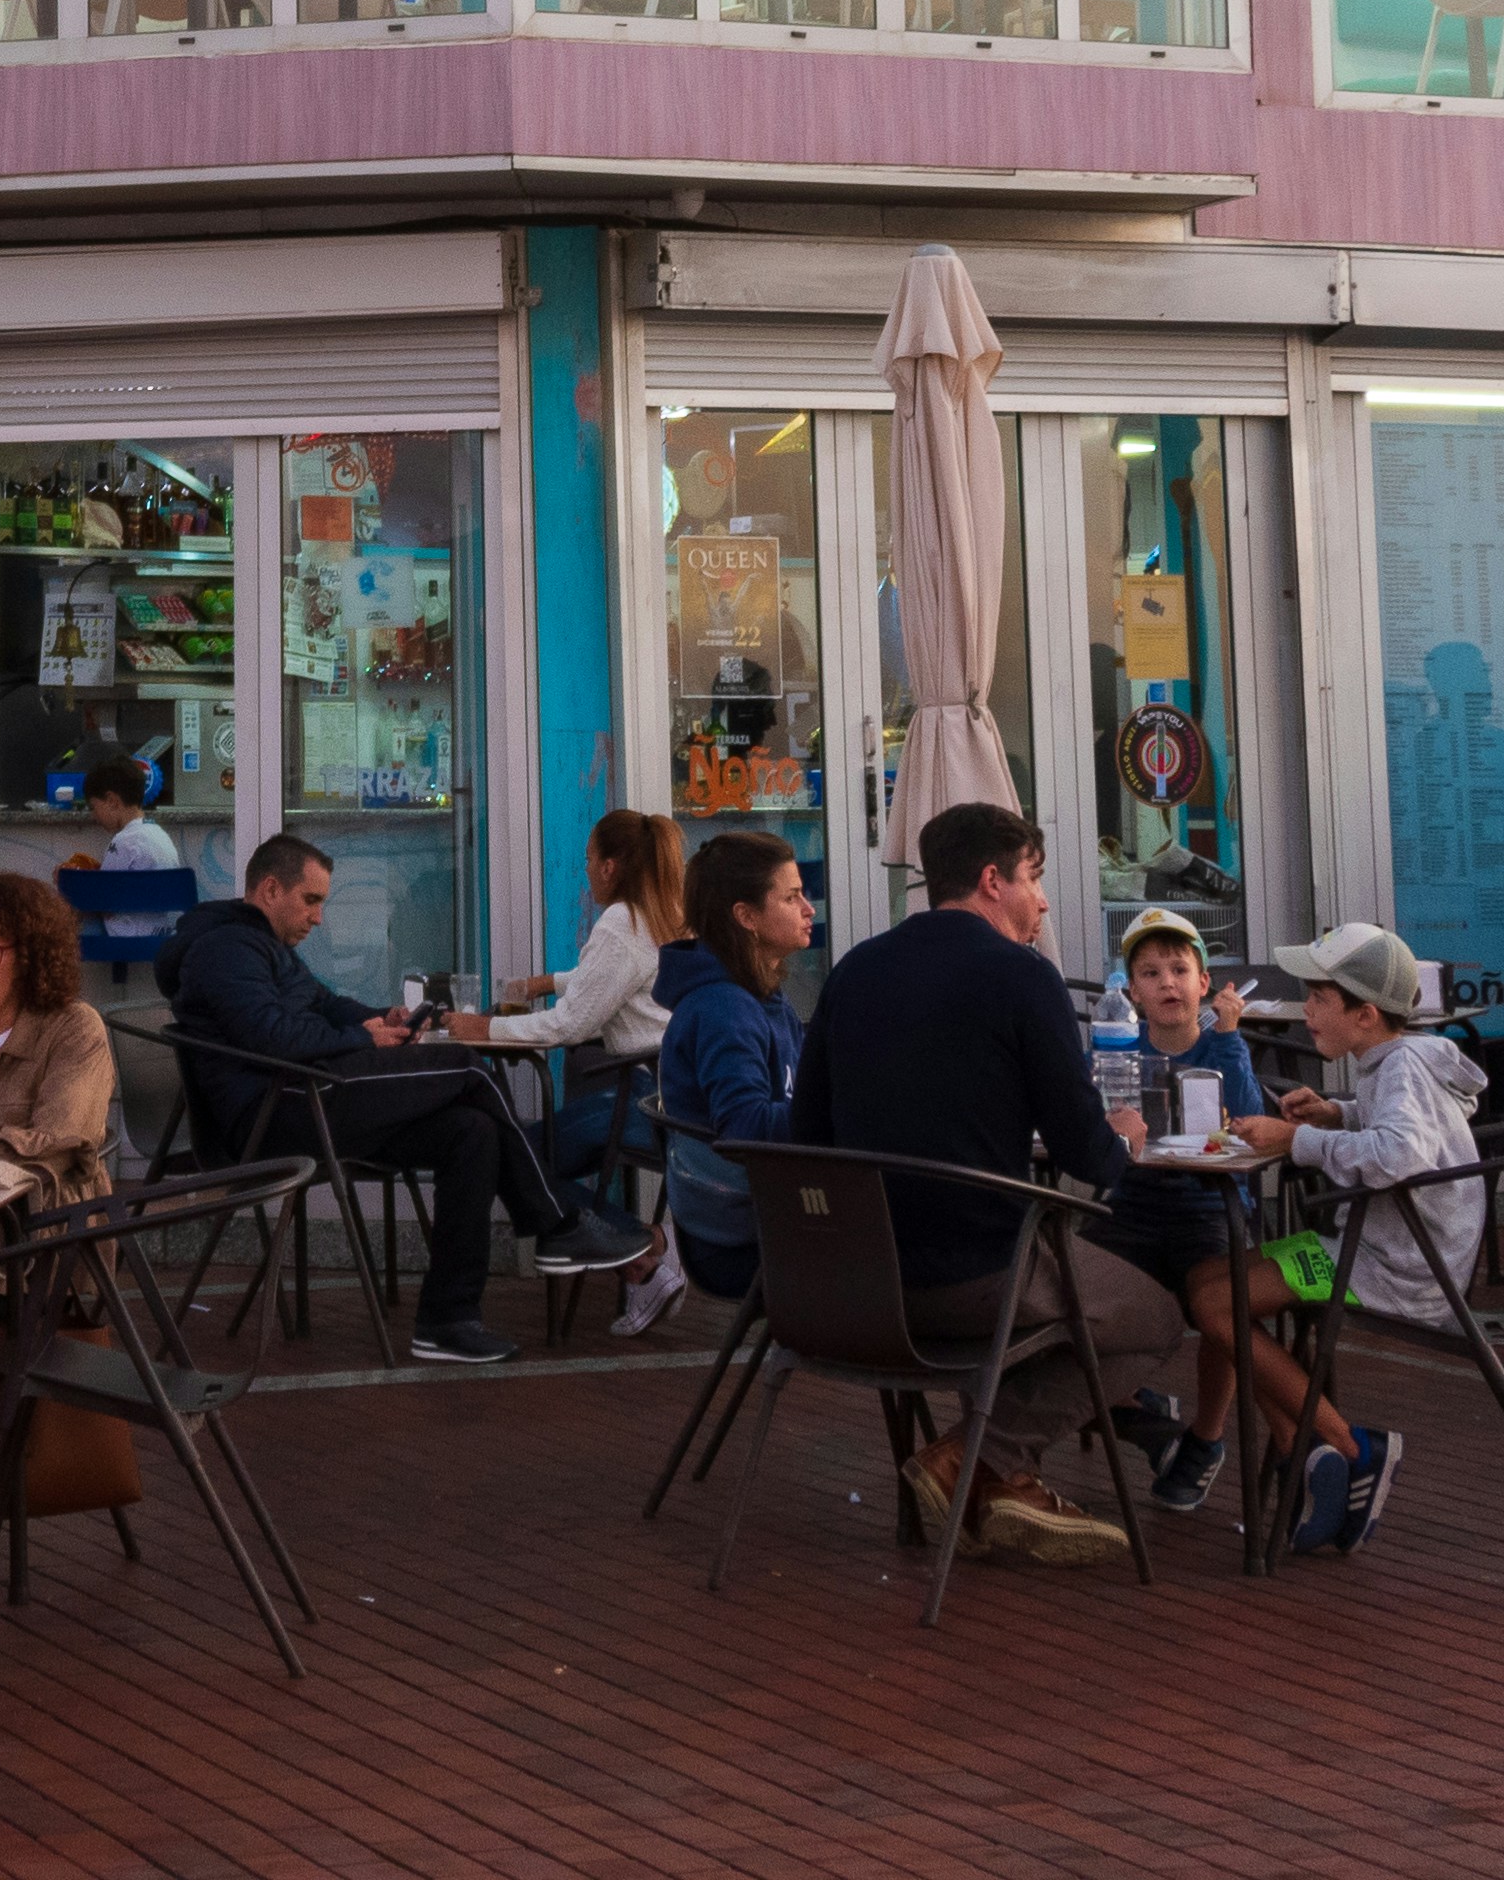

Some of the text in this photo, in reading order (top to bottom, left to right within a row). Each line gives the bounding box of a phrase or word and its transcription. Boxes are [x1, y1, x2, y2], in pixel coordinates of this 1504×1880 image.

[688, 548, 768, 579] QUEEN
[734, 626, 762, 647] 22
[716, 734, 751, 745] TERRAZA
